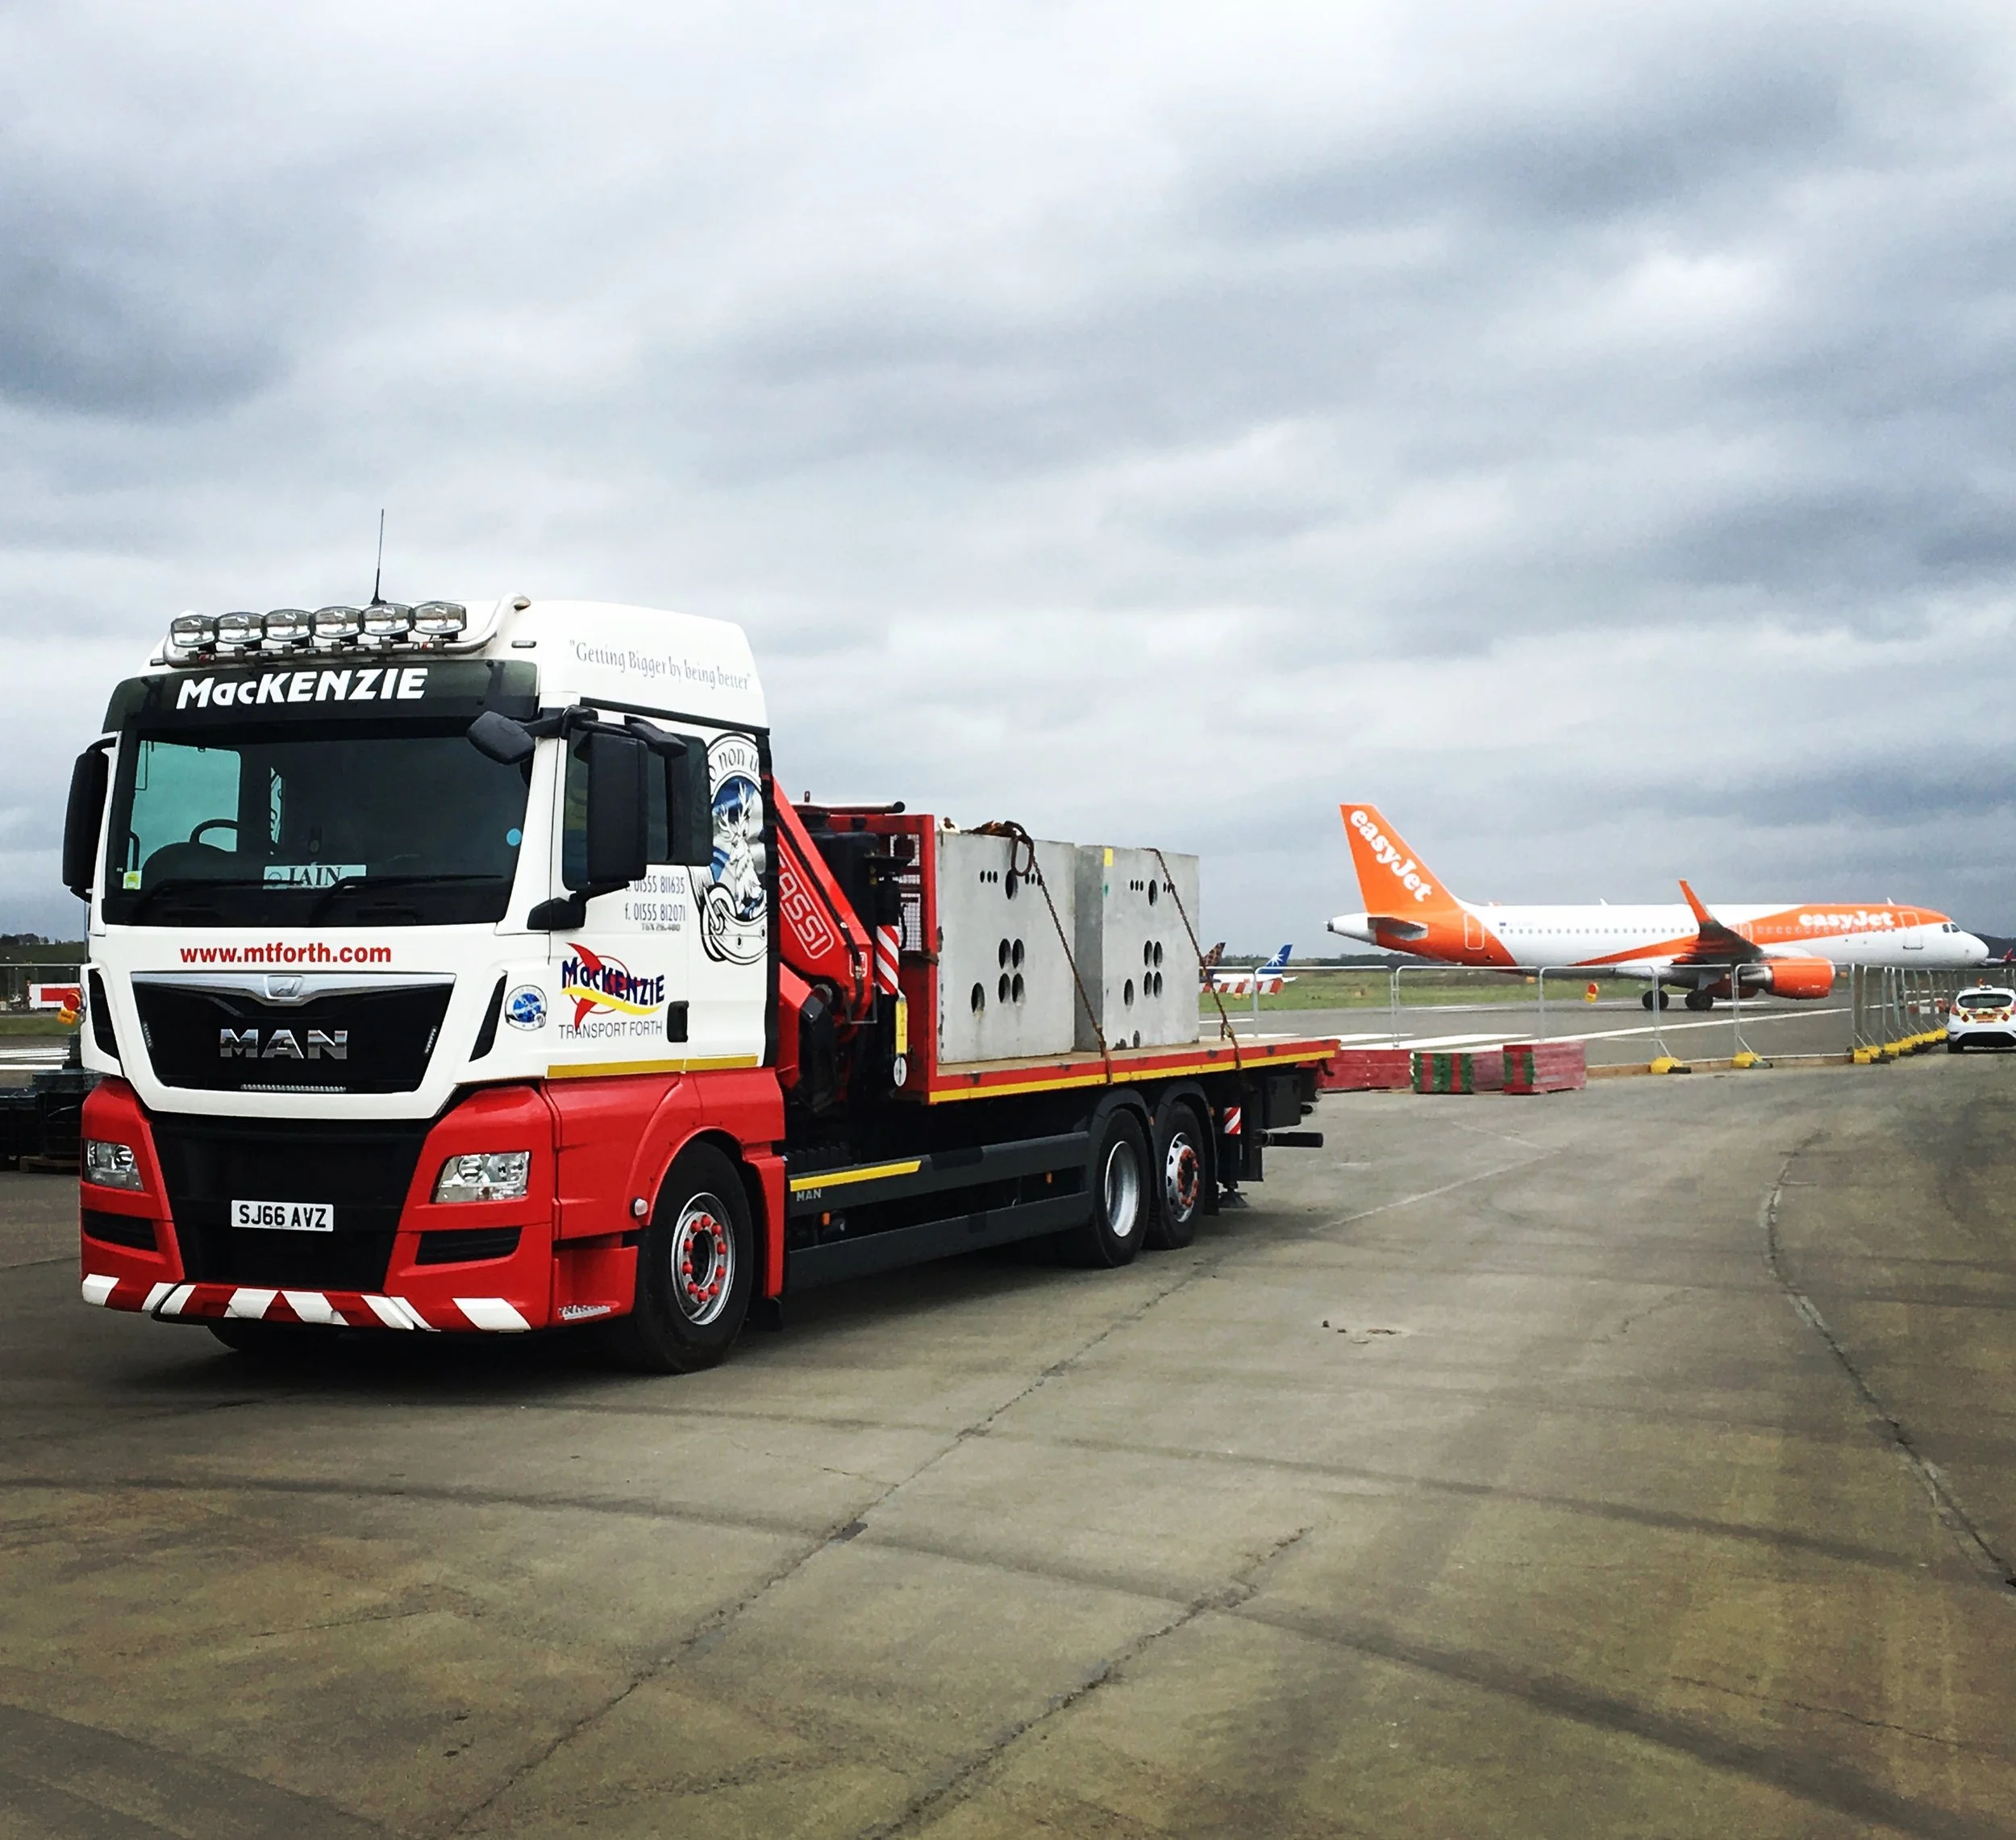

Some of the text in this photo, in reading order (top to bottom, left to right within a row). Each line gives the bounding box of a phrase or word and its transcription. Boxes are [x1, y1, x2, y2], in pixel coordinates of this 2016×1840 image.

[629, 650, 666, 678] Bigger
[669, 656, 682, 683] by
[684, 659, 716, 689] being
[176, 668, 428, 710] MacKENZIE
[719, 748, 744, 771] non
[1350, 809, 1432, 902] easyJet
[289, 866, 342, 886] IAIN
[633, 902, 657, 921] 01555
[660, 903, 686, 922] 812071
[1798, 910, 1895, 930] easyJet
[180, 943, 392, 963] www.mtforth.com
[561, 956, 665, 1006] MacKENZIE
[558, 1020, 663, 1039] TRANSPORT FORTH
[219, 1028, 348, 1060] MAN
[796, 1189, 823, 1202] MAN
[239, 1204, 327, 1228] SJ66 AVZ
